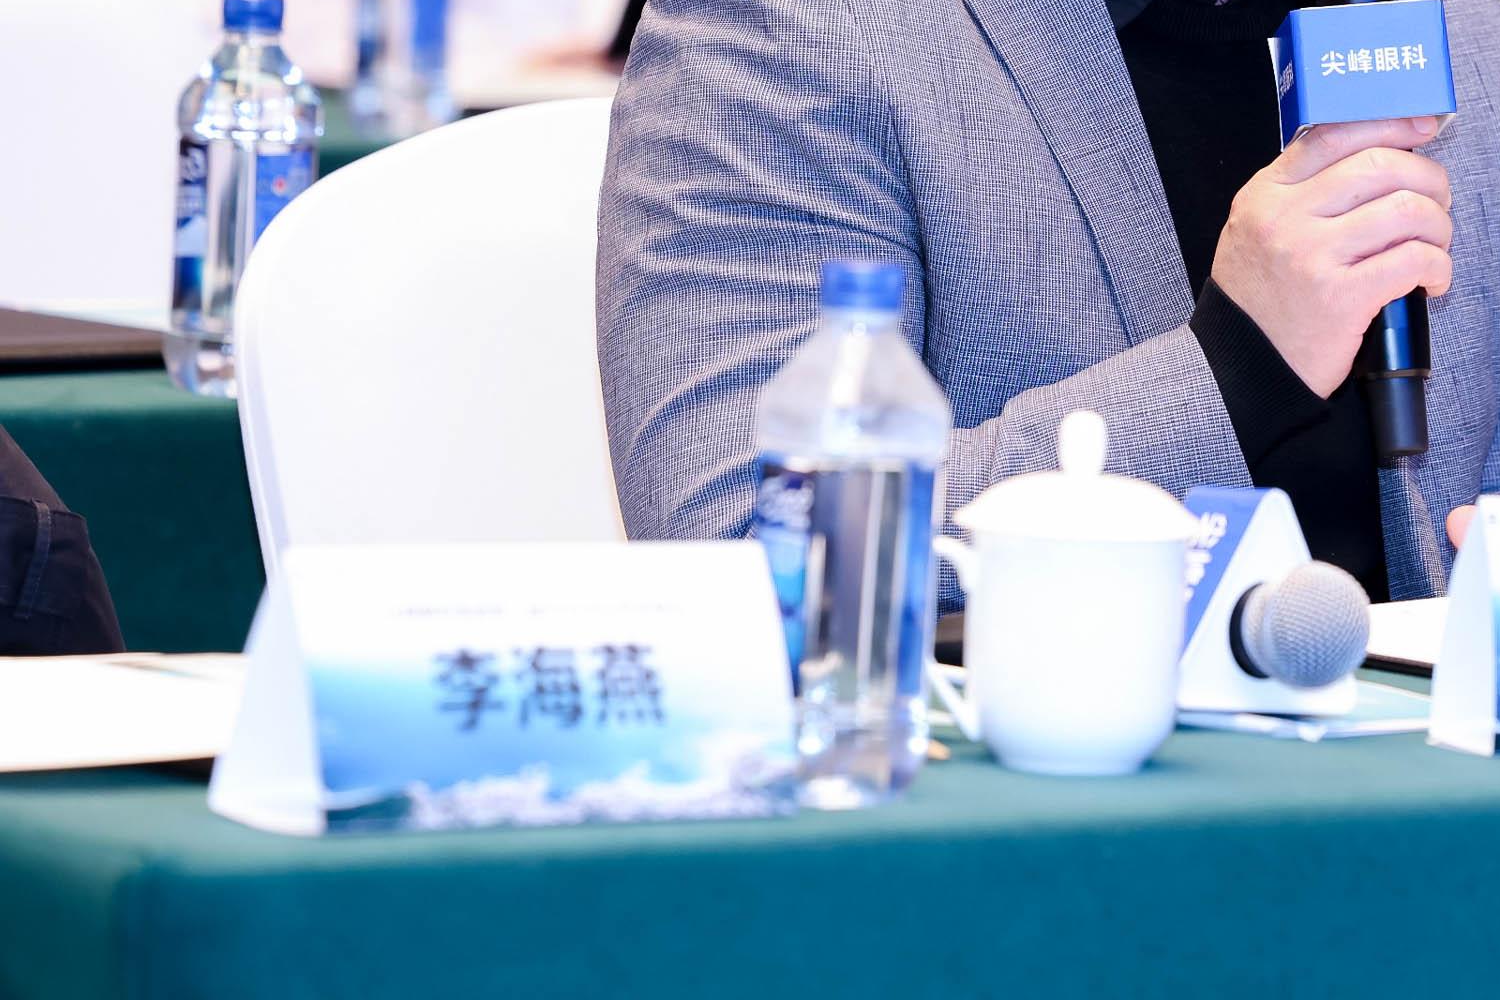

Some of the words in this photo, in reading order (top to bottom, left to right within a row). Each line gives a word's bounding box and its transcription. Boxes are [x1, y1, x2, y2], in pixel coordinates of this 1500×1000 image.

[1320, 44, 1428, 77] 尖峰眼科
[432, 643, 667, 731] 李海燕
